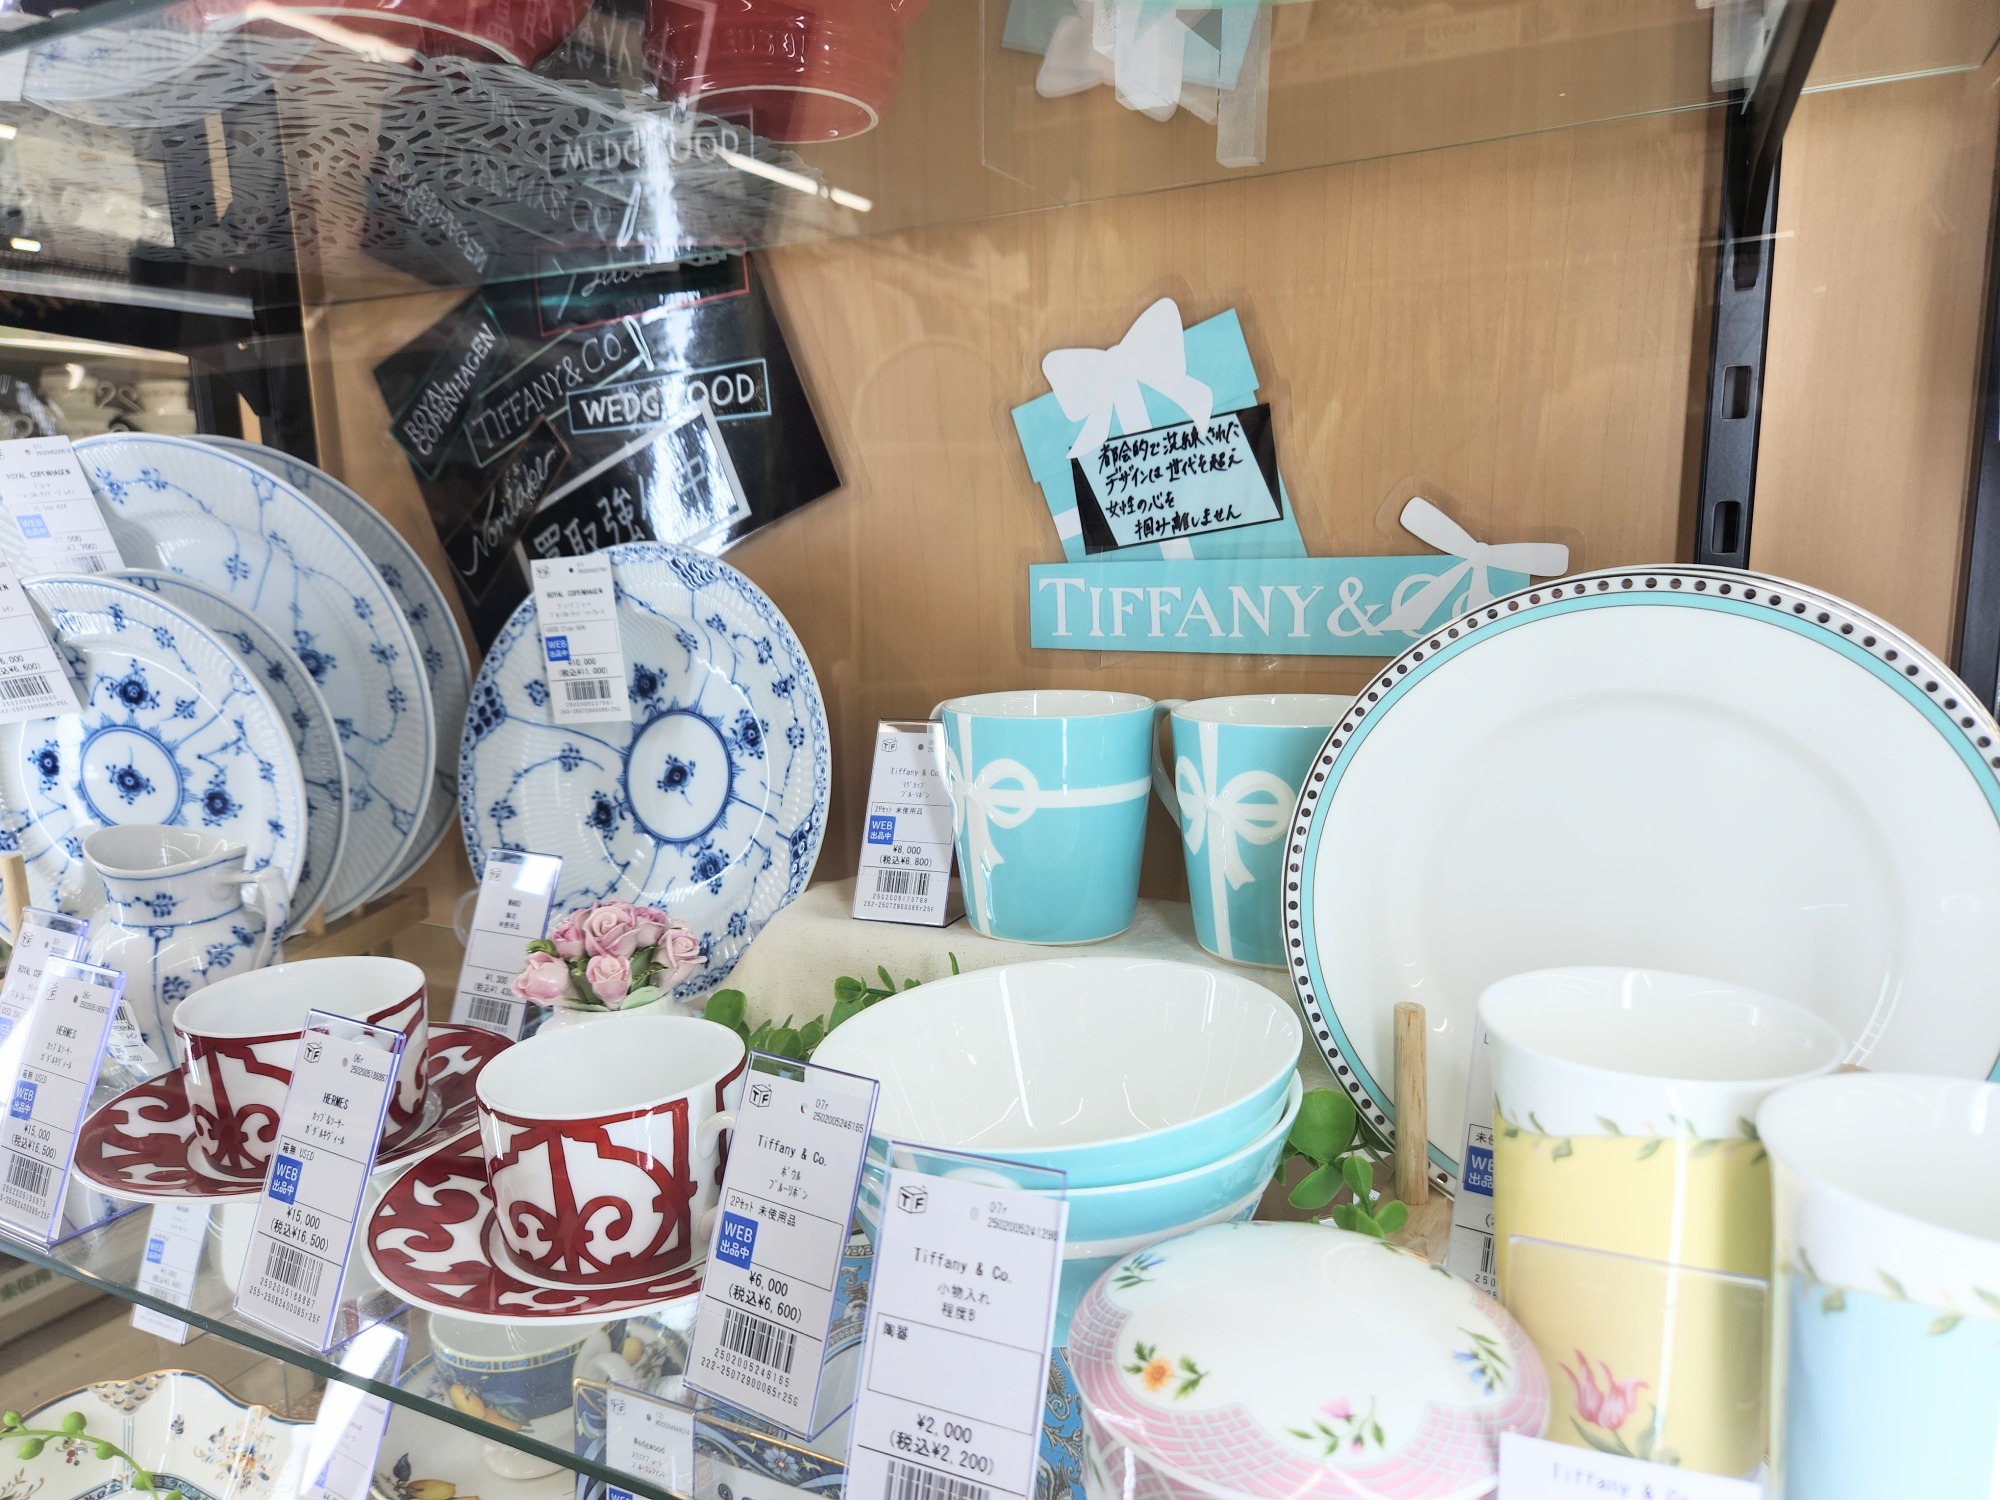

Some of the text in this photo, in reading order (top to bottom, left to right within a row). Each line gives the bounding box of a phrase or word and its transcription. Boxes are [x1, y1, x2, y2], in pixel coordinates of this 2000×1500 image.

[416, 322, 497, 457] COPENHAGEN
[1098, 420, 1240, 474] 都会的で洗練された
[1106, 448, 1243, 496] デザインは世代を超え
[1106, 490, 1175, 519] 女性の心を
[1135, 504, 1242, 541] 掴み離しません
[546, 587, 604, 598] ROYAL COPENHAGEN
[547, 639, 567, 649] WEB
[549, 650, 569, 659] 出品中
[567, 658, 597, 667] ¥10,000
[559, 667, 609, 678] (税込¥11,000)
[890, 767, 918, 777] Tiffany
[921, 768, 927, 776] &
[895, 806, 923, 815] 未使用品
[872, 820, 893, 830] WEB
[870, 831, 892, 841] 出品中
[893, 844, 922, 855] ¥8,000
[879, 855, 932, 867] (税込¥8,800)
[18, 964, 32, 976] ROYAL
[485, 973, 508, 985] ¥1,300
[56, 1025, 78, 1040] HERMES
[35, 1072, 48, 1084] USED
[16, 1086, 34, 1102] WEB
[322, 1092, 349, 1110] HERMES
[12, 1101, 31, 1114] 出品中
[815, 1098, 829, 1111] 07r
[24, 1123, 51, 1142] ¥15,000
[11, 1134, 57, 1160] (税込¥16,500)
[282, 1142, 315, 1161] 箱無 USED
[758, 1134, 827, 1167] Tiffany & Co.
[276, 1162, 298, 1181] WEB
[272, 1179, 295, 1195] 出品中
[758, 1205, 796, 1228] 未使用品
[989, 1200, 1007, 1214] 07r
[286, 1206, 321, 1230] ¥15,000
[270, 1218, 329, 1252] (税込¥16,500)
[724, 1220, 753, 1243] WEB
[720, 1239, 750, 1260] 出品中
[914, 1246, 1013, 1284] Tiffany & Co.
[749, 1271, 789, 1297] ¥6,000
[728, 1282, 802, 1324] (税込¥6,600)
[937, 1281, 991, 1307] 小物入れ
[714, 1347, 790, 1389] 2502005246165
[917, 1412, 973, 1445] ¥2,000
[889, 1428, 995, 1476] (税込¥2,200)
